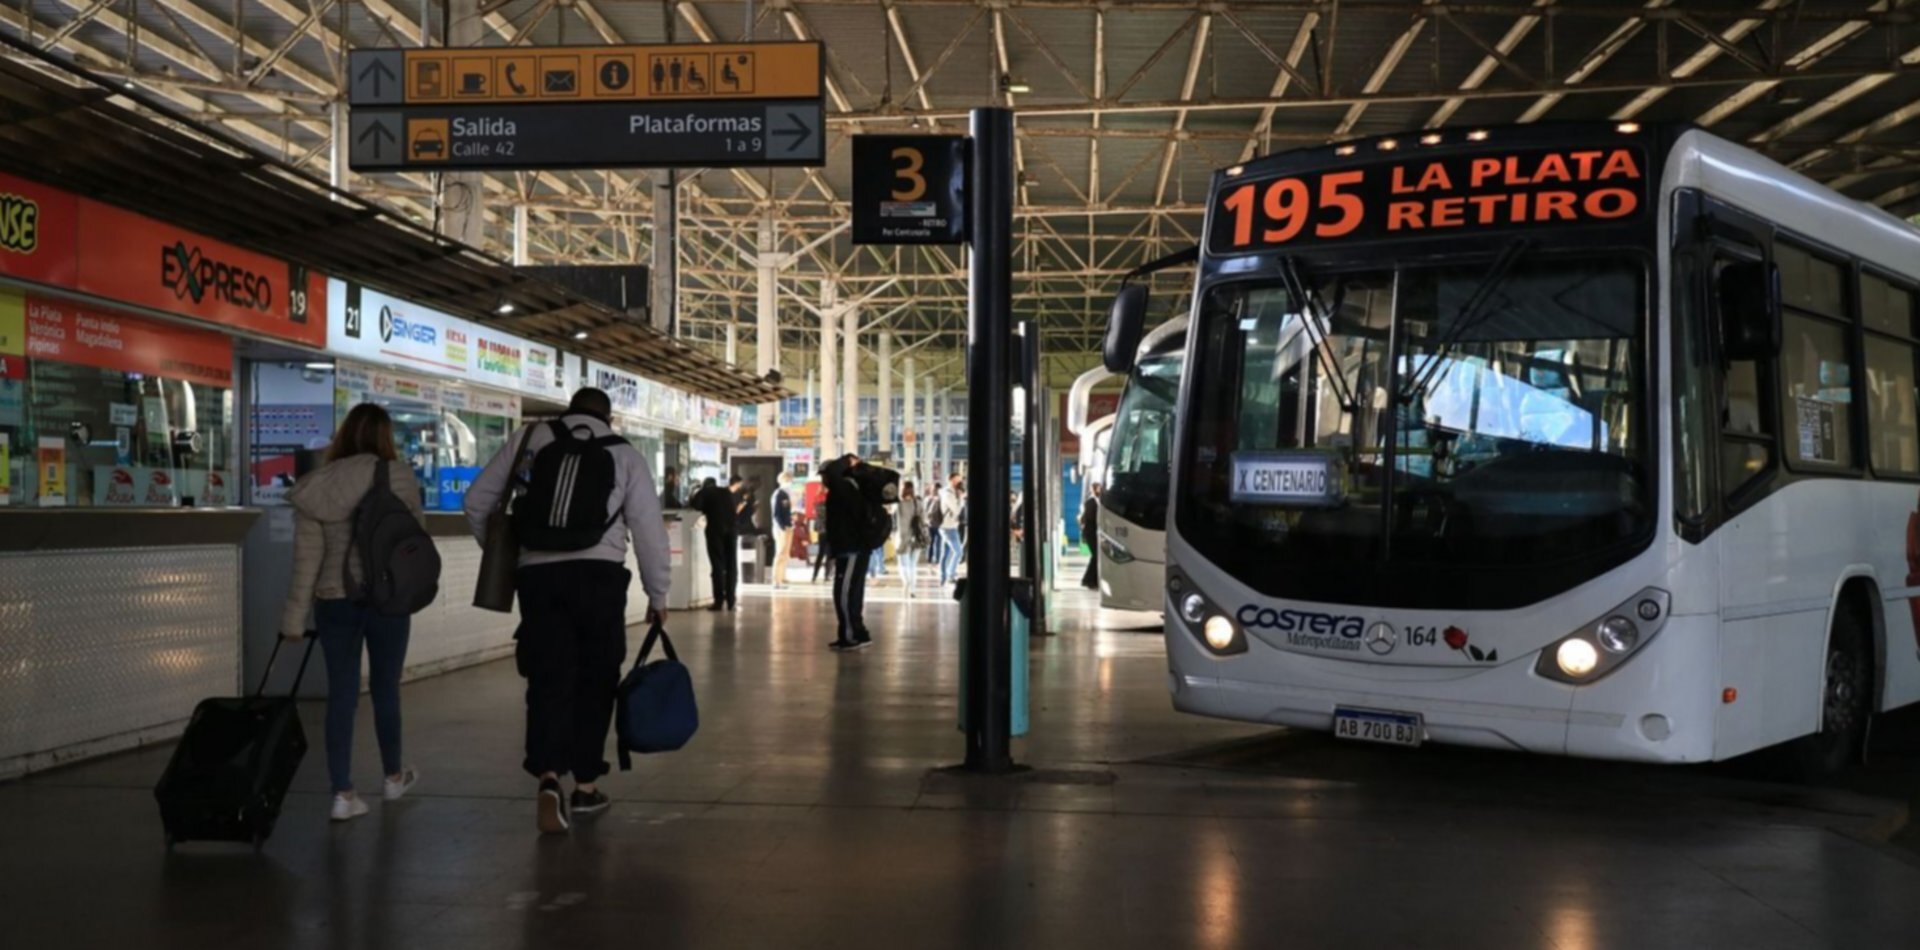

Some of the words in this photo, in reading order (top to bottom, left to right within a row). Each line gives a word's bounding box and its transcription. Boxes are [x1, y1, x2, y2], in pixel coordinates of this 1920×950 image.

[452, 117, 516, 136] Salida
[629, 114, 762, 133] Plataformas
[452, 141, 490, 156] Calle
[495, 141, 515, 156] 42
[725, 138, 732, 151] 1
[737, 140, 746, 151] a
[752, 137, 762, 152] 9
[891, 147, 927, 202] 3
[1391, 163, 1452, 194] LA
[1470, 149, 1640, 187] PLATA
[1223, 170, 1365, 247] 195
[1387, 188, 1638, 231] RETIRO
[161, 241, 272, 312] EXPRESO
[29, 304, 39, 318] La
[41, 306, 62, 322] Plata
[290, 290, 306, 316] 19
[76, 313, 99, 330] Punta
[347, 307, 359, 330] 21
[392, 317, 437, 346] SINGER
[1239, 470, 1248, 491] X
[1253, 469, 1327, 492] CENTENARIO
[1405, 626, 1437, 647] 164
[1339, 719, 1358, 736] AB
[1363, 721, 1392, 740] 700
[1396, 724, 1414, 743] BJ
